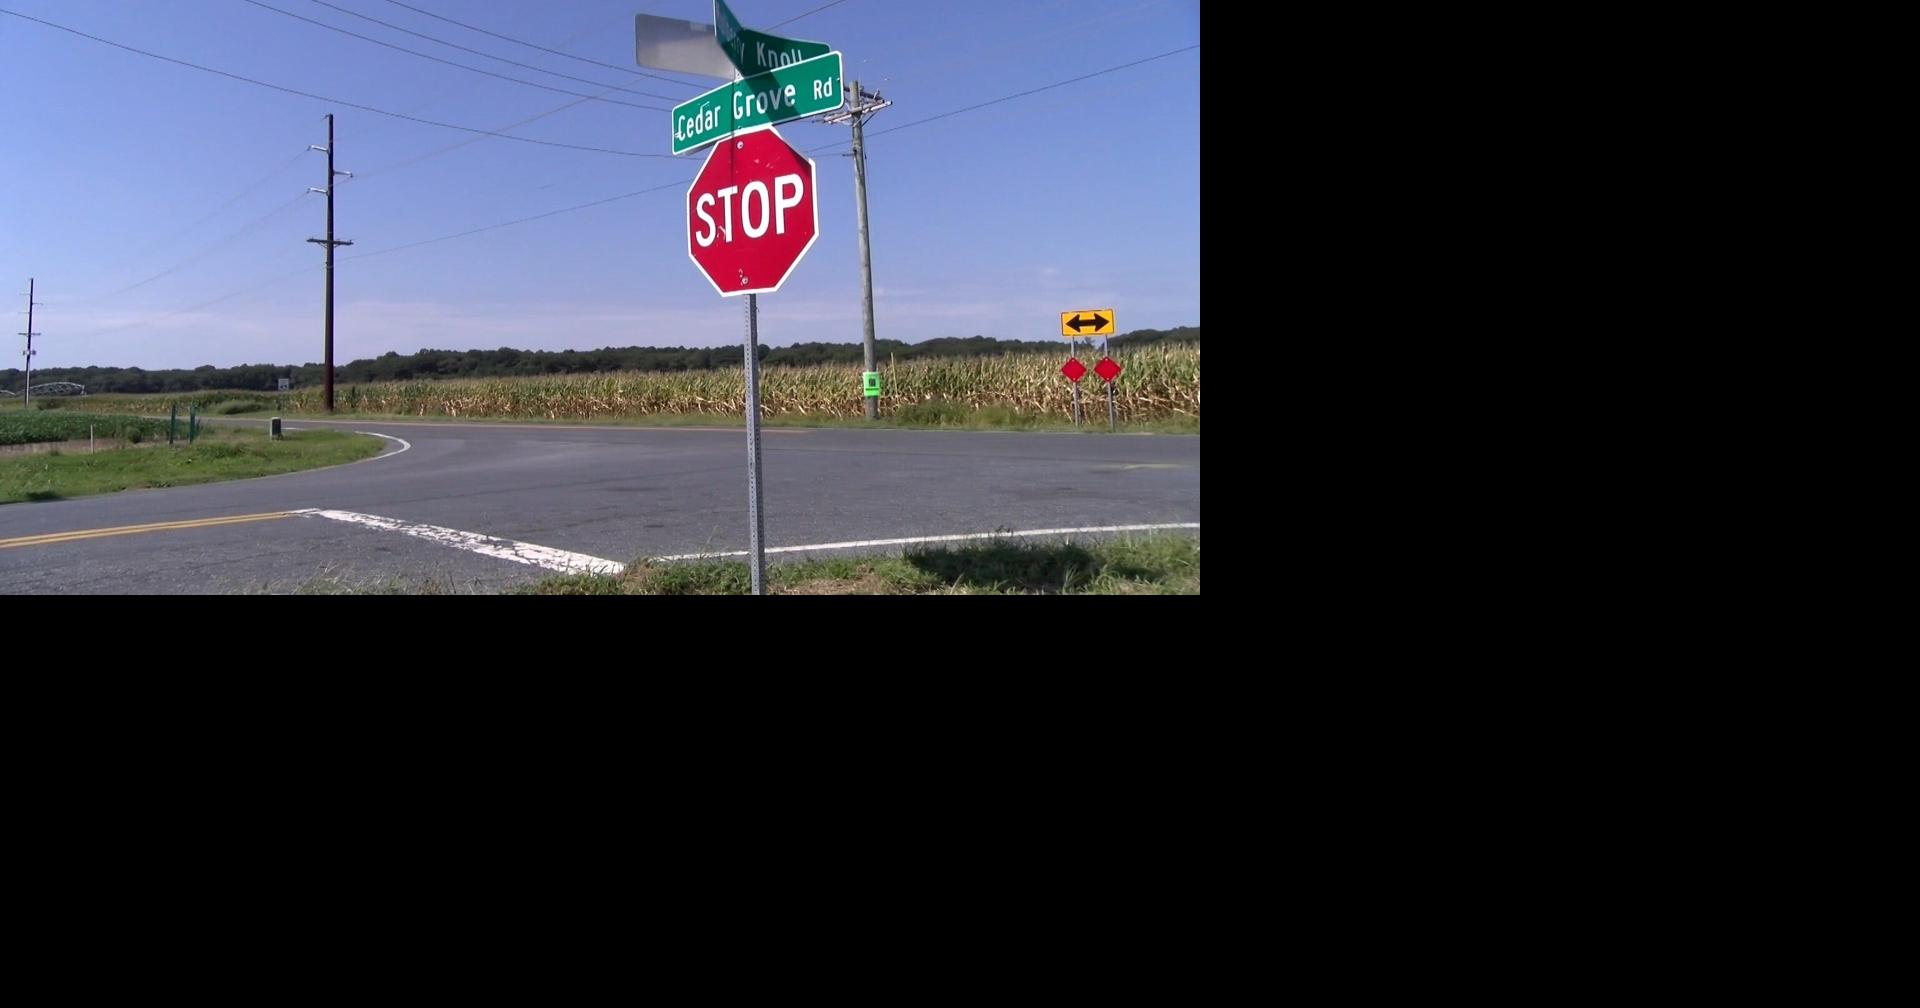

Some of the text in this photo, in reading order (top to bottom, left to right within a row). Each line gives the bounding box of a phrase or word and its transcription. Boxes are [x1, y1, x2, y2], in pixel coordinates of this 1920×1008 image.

[677, 77, 833, 141] Cedar Grove Rd
[695, 173, 804, 247] STOP
